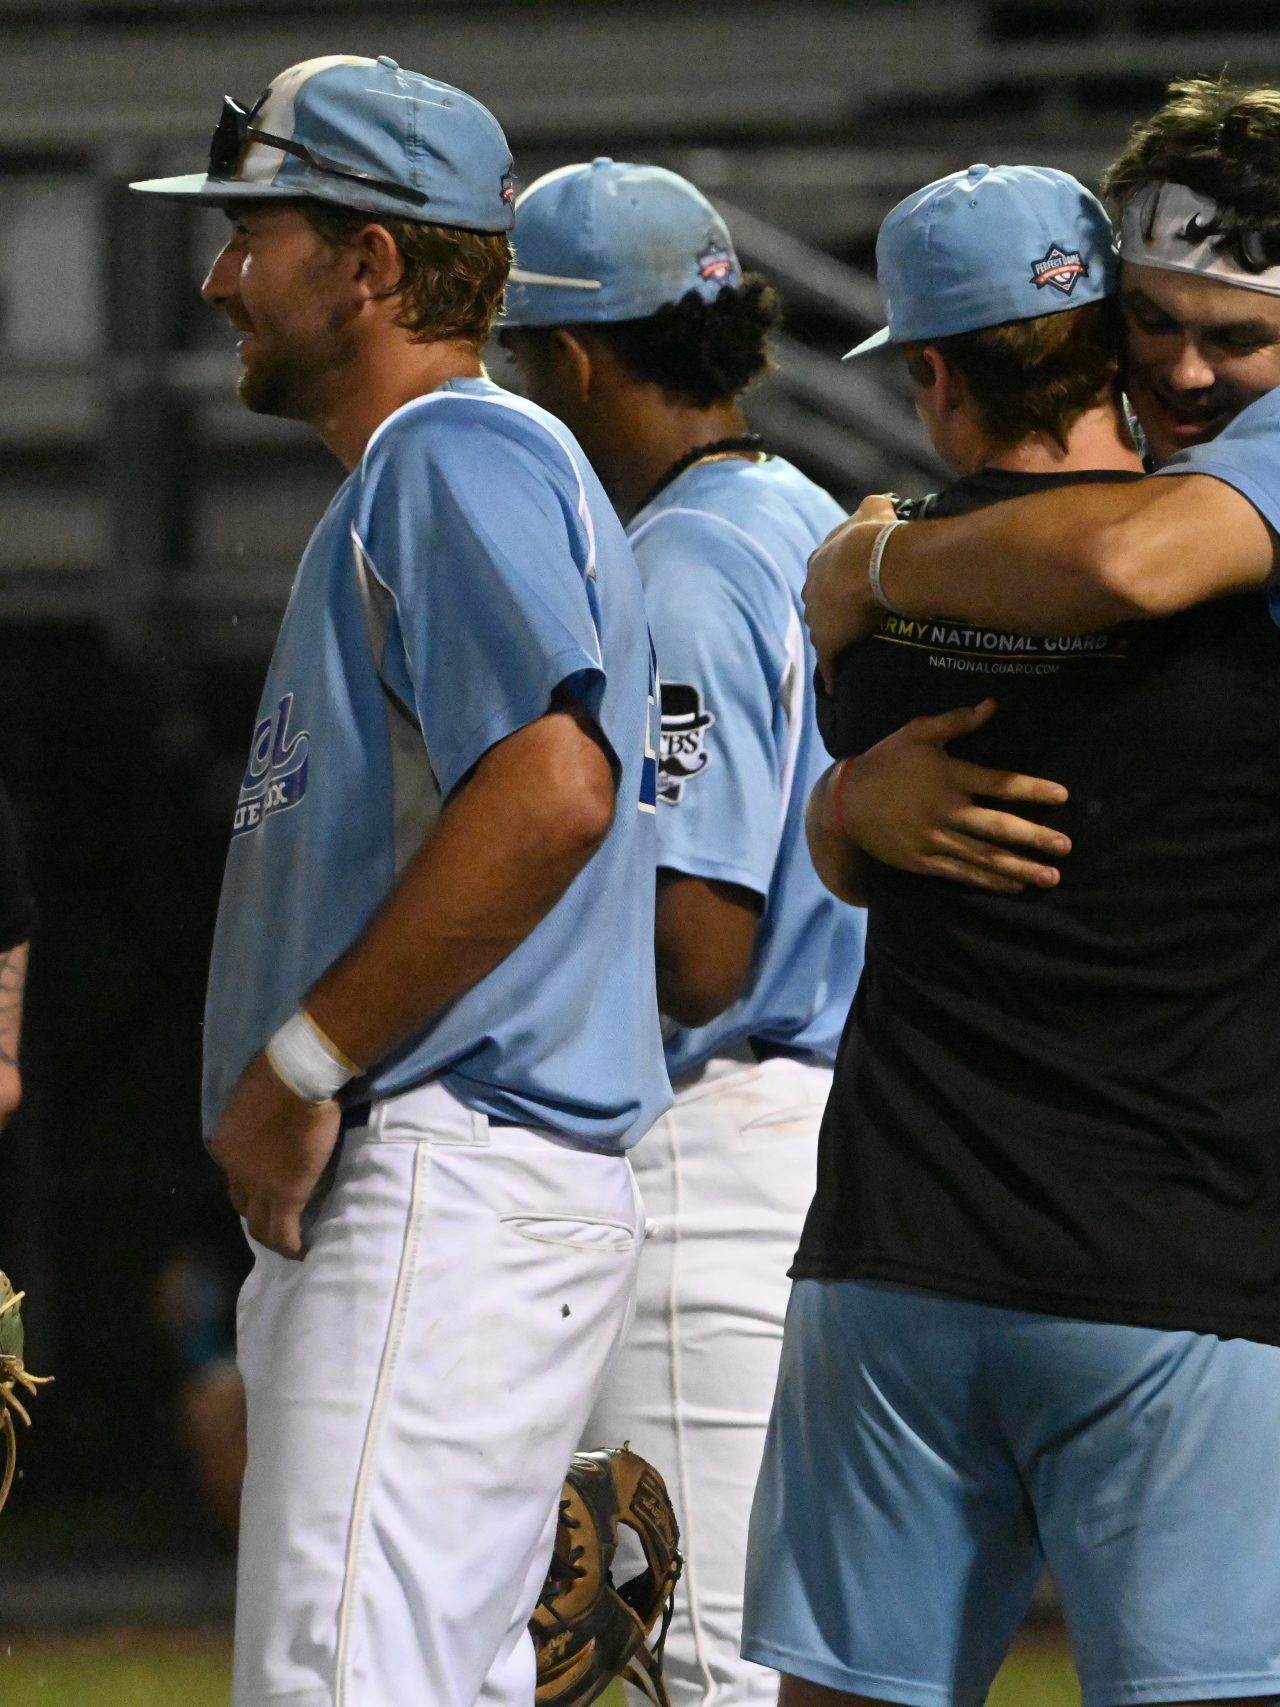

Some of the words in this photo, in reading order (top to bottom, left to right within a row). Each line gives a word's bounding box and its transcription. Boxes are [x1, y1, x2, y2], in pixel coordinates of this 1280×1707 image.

[1035, 258, 1062, 274] PERFECT
[931, 626, 1038, 651] NATIONAL
[1044, 634, 1108, 651] GUARD
[929, 655, 1059, 675] NATIONALGUARD.COM
